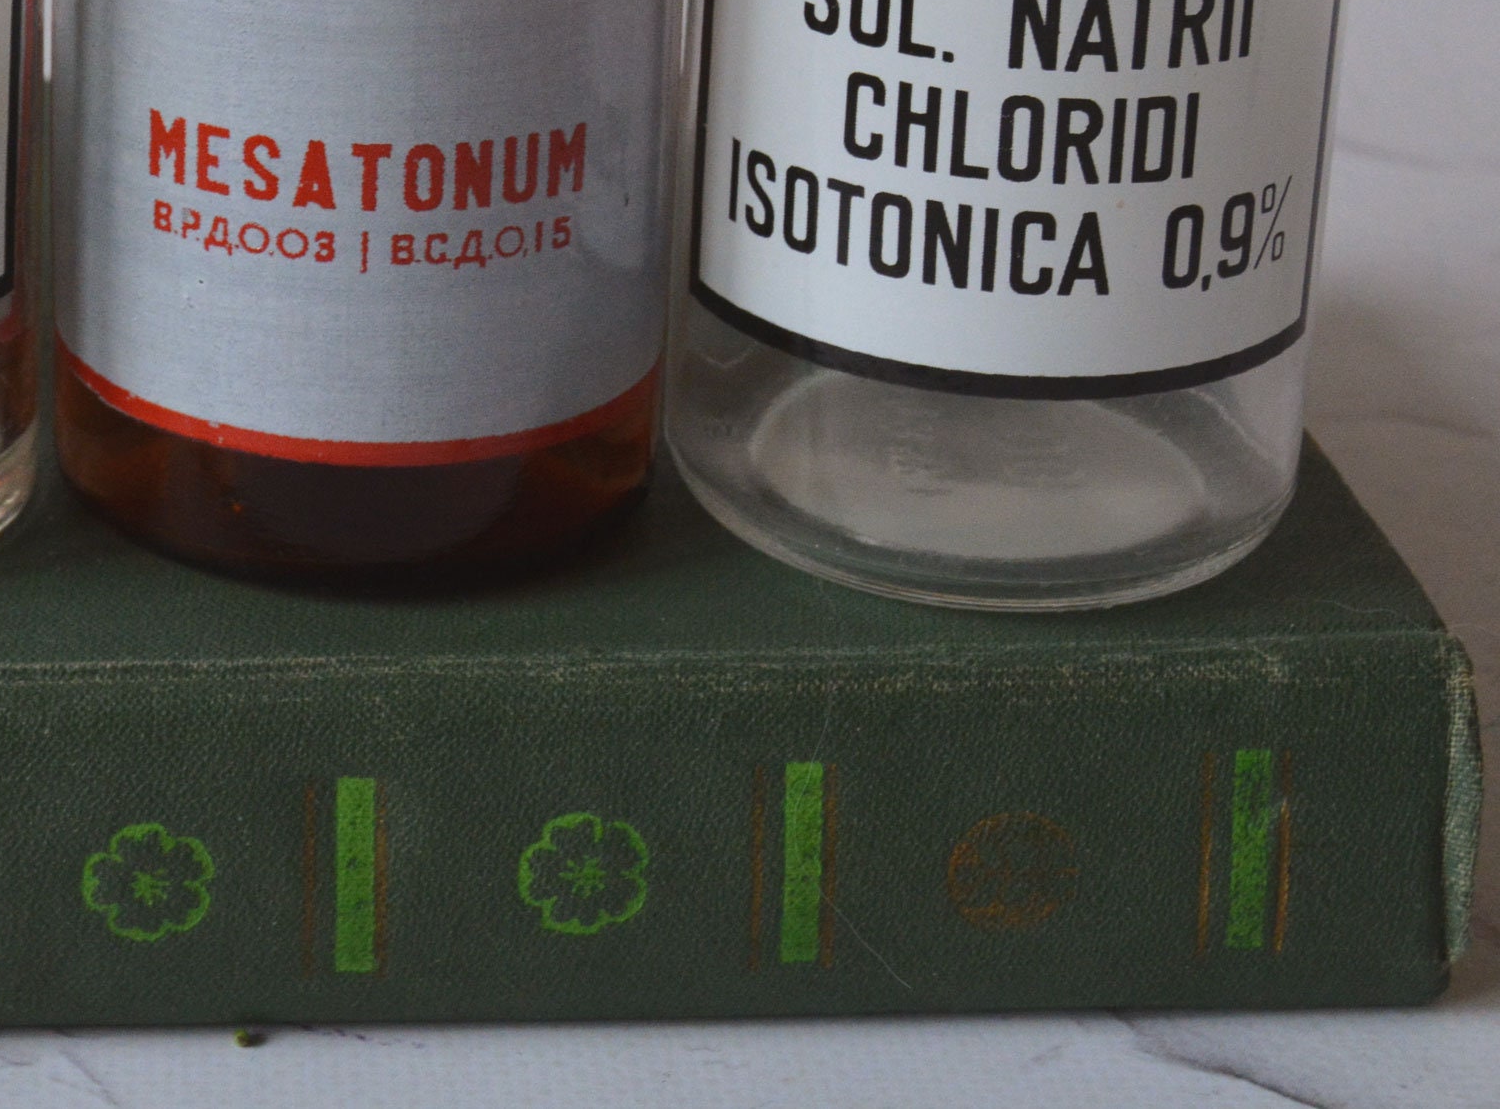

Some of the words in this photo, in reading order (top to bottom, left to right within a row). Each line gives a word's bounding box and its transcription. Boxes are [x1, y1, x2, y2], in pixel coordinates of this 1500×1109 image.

[148, 107, 588, 212] MESATONUM
[843, 70, 1200, 185] CHLORIDI
[728, 137, 1110, 296] ISOTONICA
[1160, 174, 1293, 292] 0,9%
